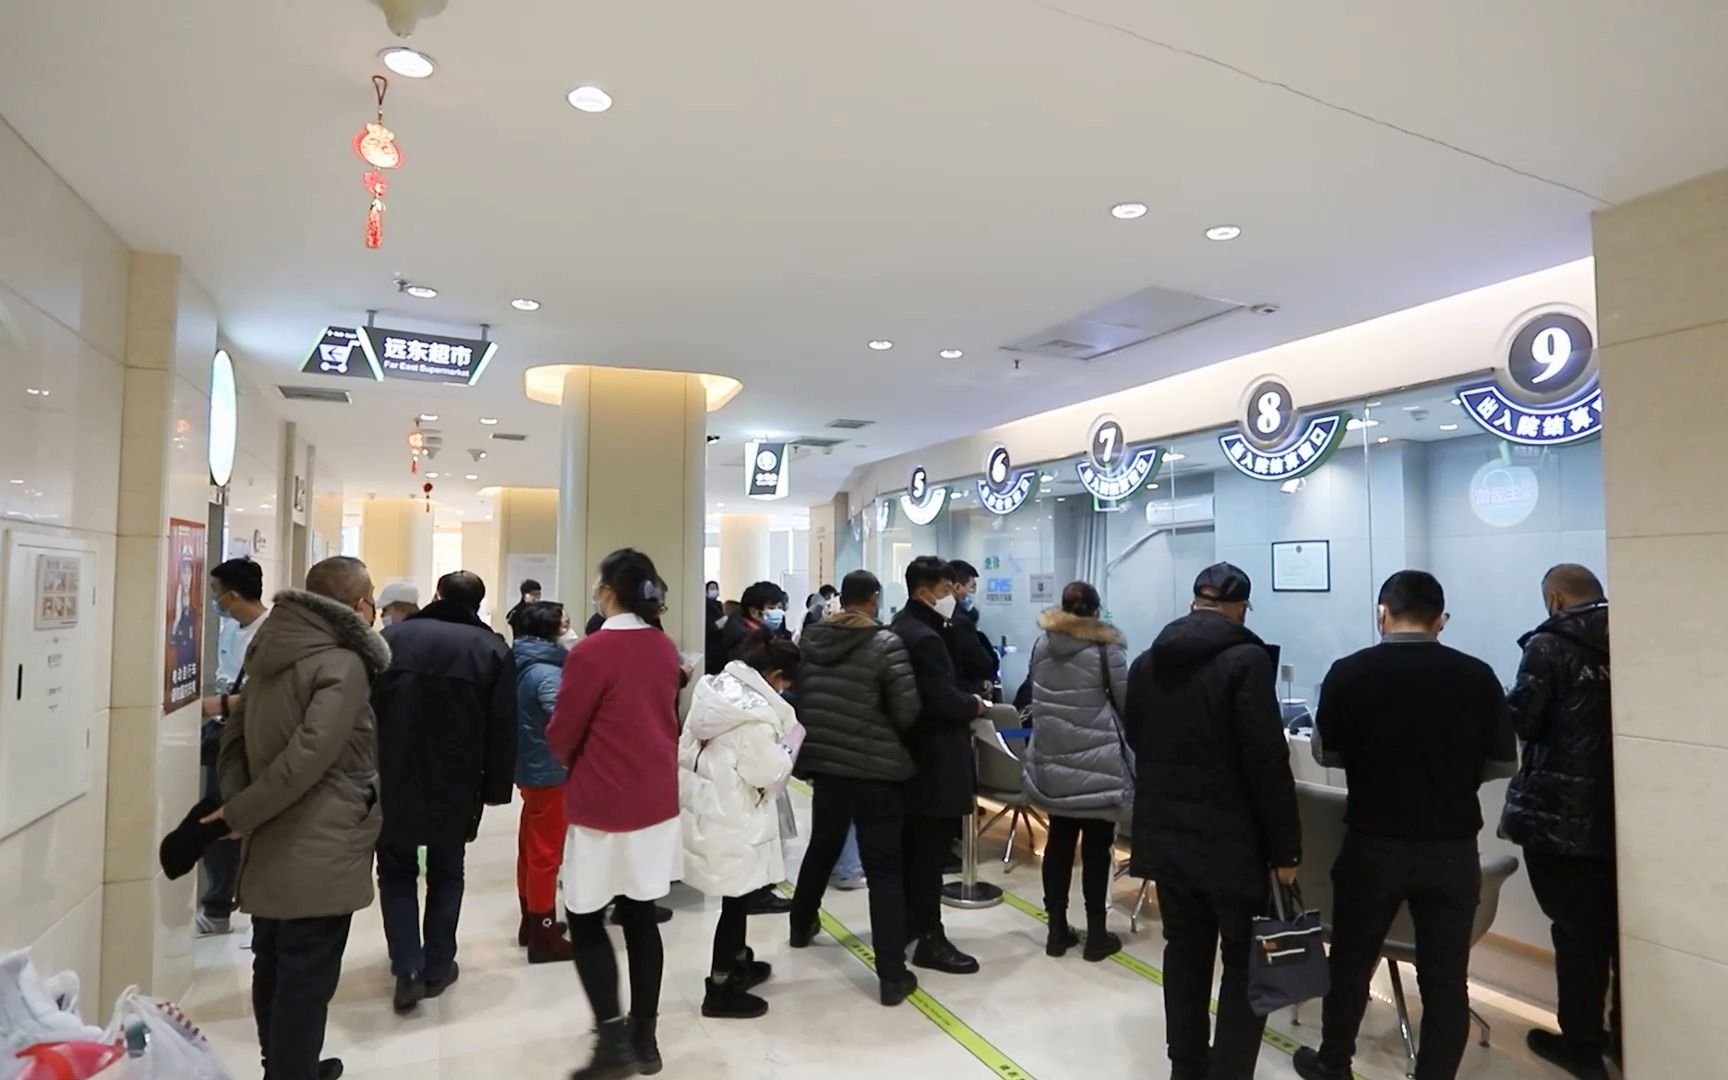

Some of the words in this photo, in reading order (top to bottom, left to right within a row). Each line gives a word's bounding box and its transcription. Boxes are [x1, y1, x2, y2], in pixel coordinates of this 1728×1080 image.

[383, 337, 472, 367] 远东超市
[383, 360, 399, 369] Far
[400, 361, 419, 372] East
[1531, 327, 1572, 384] 9
[1257, 391, 1281, 434] 8
[1099, 426, 1117, 462] 7
[991, 452, 1007, 483] 6
[912, 471, 925, 498] 5
